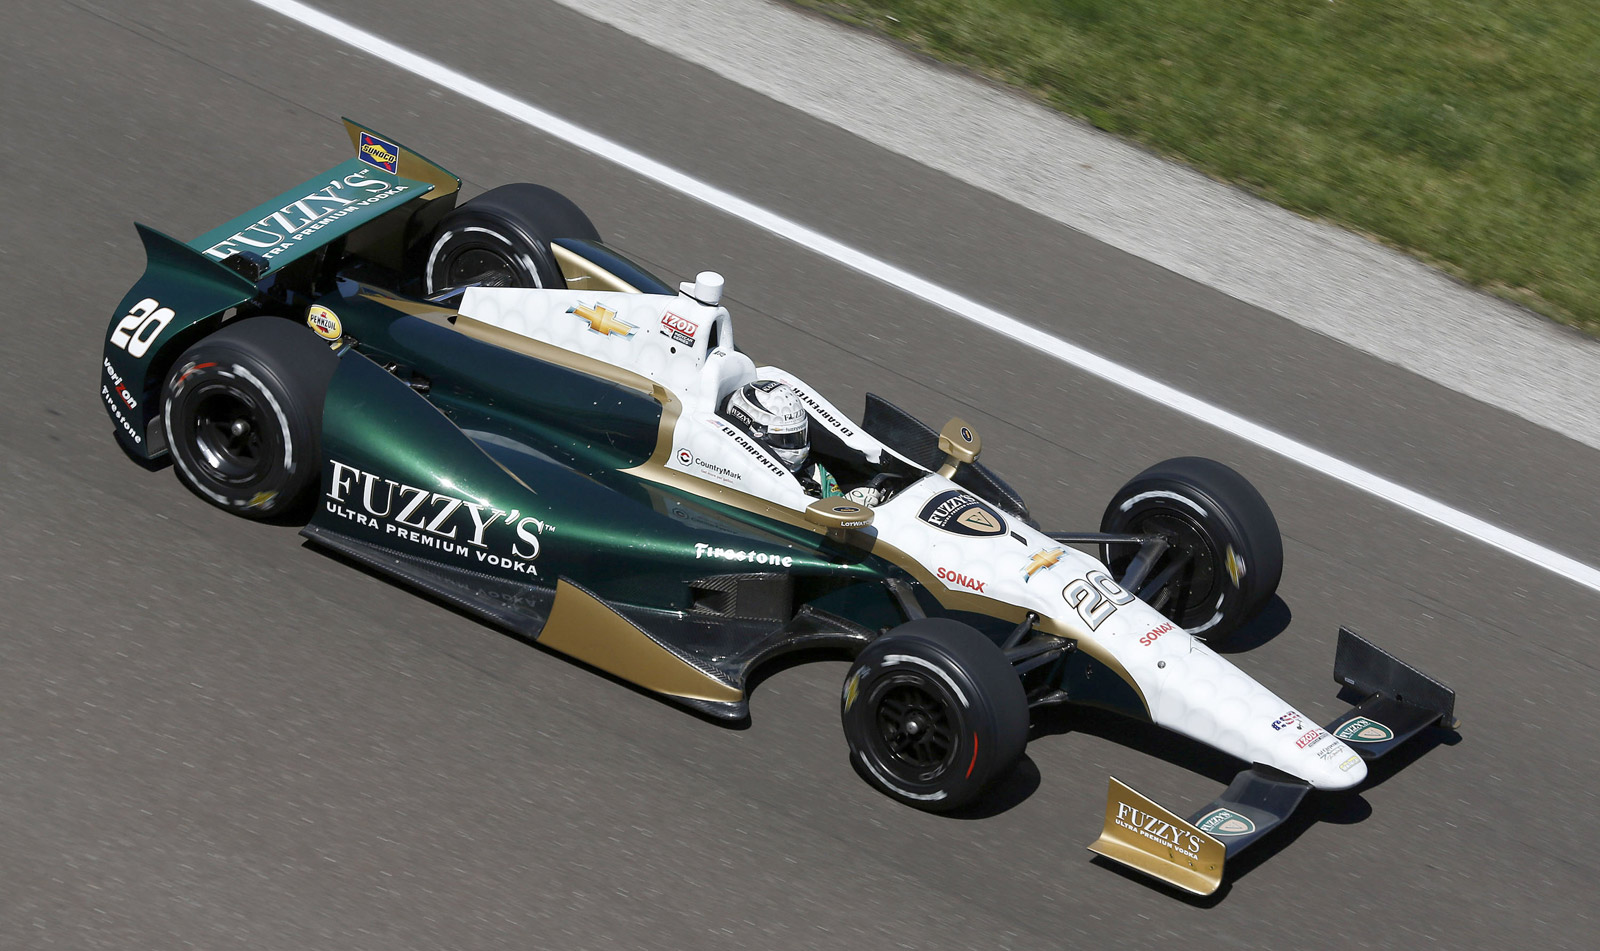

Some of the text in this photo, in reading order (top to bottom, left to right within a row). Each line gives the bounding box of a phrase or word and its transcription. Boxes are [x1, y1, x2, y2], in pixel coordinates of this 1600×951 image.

[363, 145, 395, 163] SUNOCO
[292, 205, 361, 241] PREMIUM
[357, 185, 409, 206] VODKA
[110, 298, 176, 358] 20
[311, 314, 336, 331] PENNZOIL
[662, 312, 697, 335] IZOD
[104, 357, 137, 410] verizon
[102, 385, 141, 444] Firestone
[792, 387, 854, 437] ED CARPENTER
[695, 457, 742, 481] CountryMark
[722, 426, 736, 437] ED
[735, 436, 785, 477] CARPENTER
[326, 459, 541, 560] FUZZY'S
[928, 494, 976, 526] FUZZY'S
[326, 501, 538, 576] ULTRA PREMIUM VODKA
[695, 543, 793, 567] Firestone
[937, 567, 986, 594] SONAX
[1062, 570, 1136, 632] 20
[1139, 622, 1177, 647] SONAX
[1297, 730, 1318, 748] IZOD
[1115, 818, 1199, 860] ULTRA PREMIUM VODKA
[1116, 801, 1200, 853] FUZZY'S
